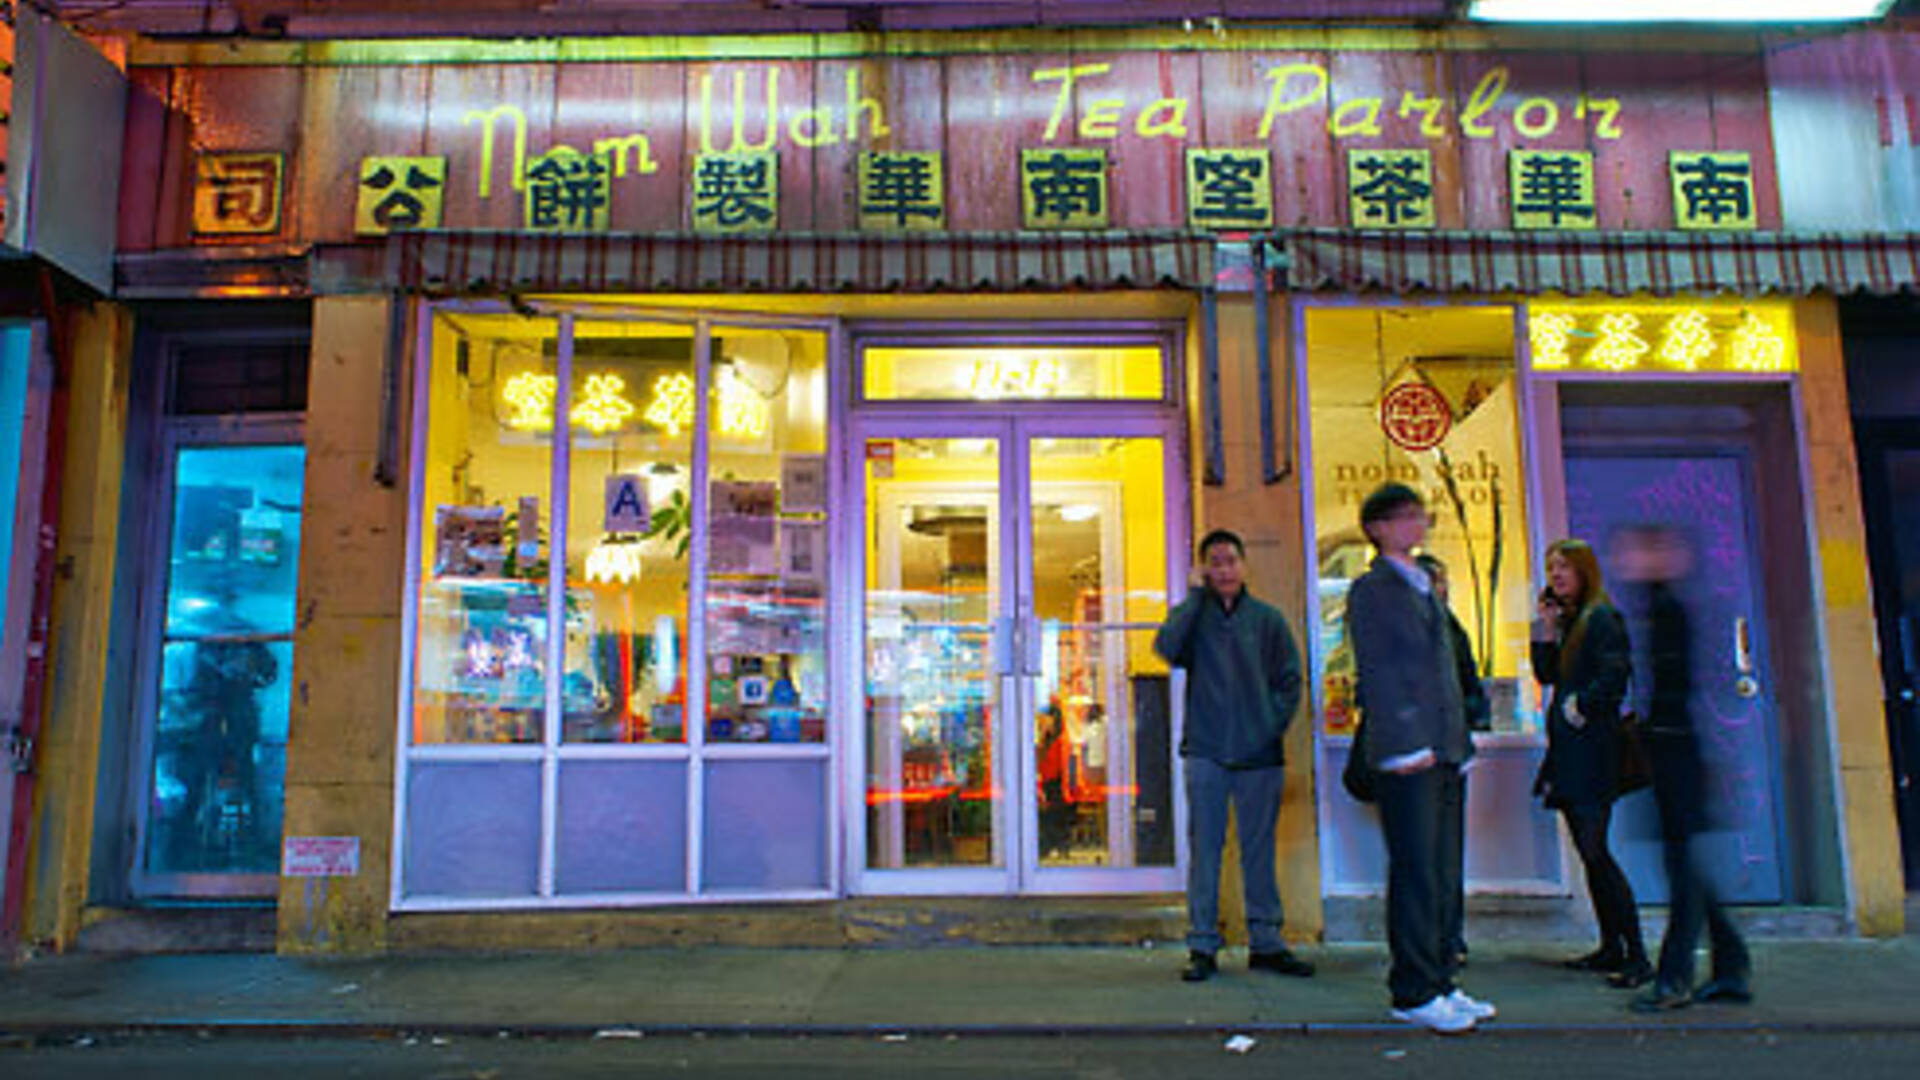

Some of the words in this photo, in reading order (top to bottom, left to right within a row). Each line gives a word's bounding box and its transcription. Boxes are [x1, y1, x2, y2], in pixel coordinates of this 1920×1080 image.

[701, 66, 891, 152] Wah
[1255, 61, 1625, 140] Parlor
[611, 481, 642, 517] A
